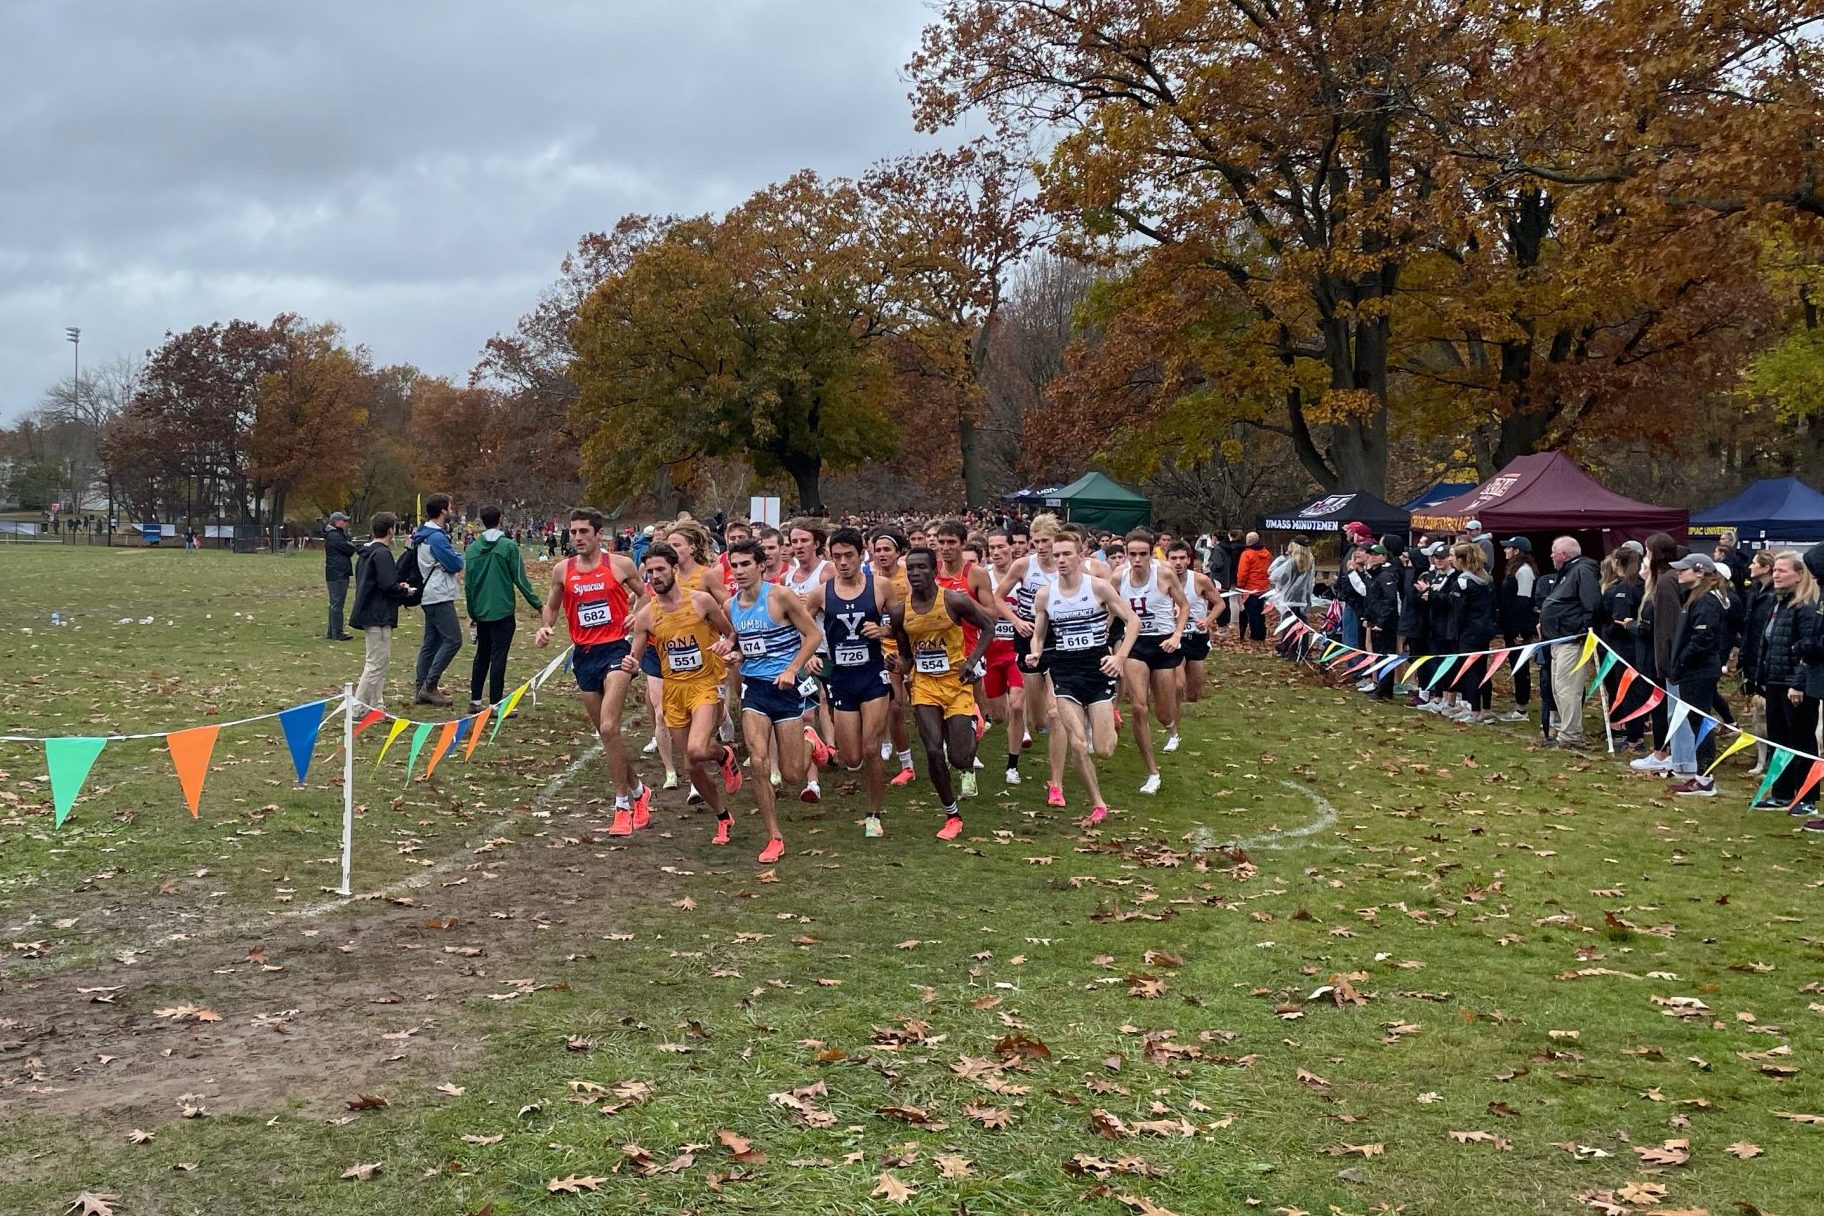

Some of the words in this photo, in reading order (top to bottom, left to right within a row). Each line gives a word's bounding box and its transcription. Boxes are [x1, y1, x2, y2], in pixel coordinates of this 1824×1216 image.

[1265, 519, 1291, 530] UMASS
[1291, 520, 1339, 532] MINUTEMEN
[573, 582, 605, 597] Syracuse
[1129, 596, 1147, 614] H
[583, 609, 606, 622] 682
[1053, 608, 1094, 620] PROVIDENCE
[836, 611, 866, 641] Y
[995, 624, 1015, 634] 490
[1140, 621, 1153, 629] 32
[743, 641, 761, 653] 474
[1067, 636, 1089, 647] 616
[674, 655, 696, 667] 551
[840, 651, 864, 662] 726
[921, 660, 944, 670] 554
